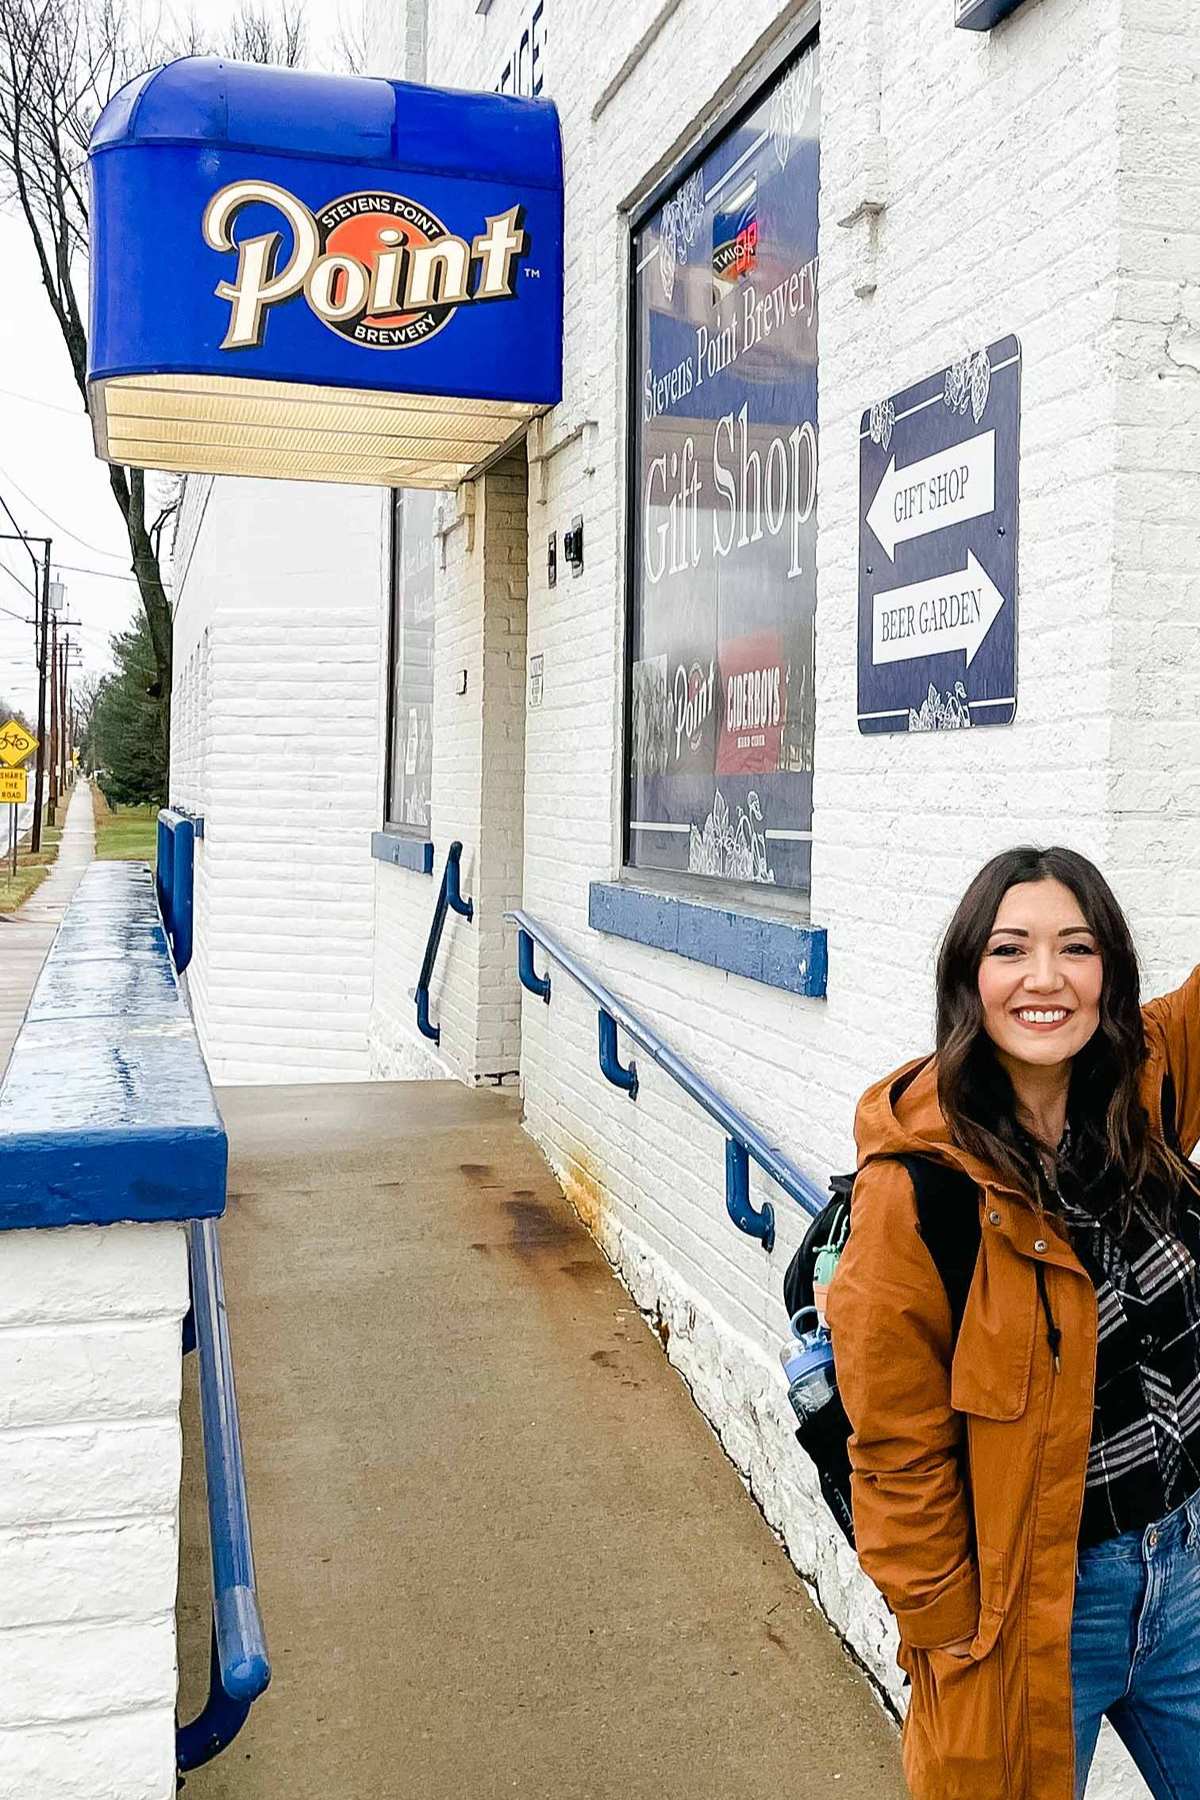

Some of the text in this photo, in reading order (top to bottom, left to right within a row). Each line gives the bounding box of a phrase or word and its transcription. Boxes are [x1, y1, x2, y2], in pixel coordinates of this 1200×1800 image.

[321, 197, 441, 237] STEVENS POINT
[202, 180, 524, 349] Point
[354, 312, 437, 344] BREWERY
[644, 255, 819, 422] Stevens Point Brewery
[644, 401, 817, 584] Gift Shop
[894, 465, 969, 523] GIFT SHOP
[881, 588, 982, 642] BEER GARDEN
[674, 656, 716, 763] Point
[727, 667, 780, 732] CIDERBOYS
[0, 771, 23, 780] SHARE
[1, 791, 21, 799] ROAD
[4, 781, 18, 790] THE
